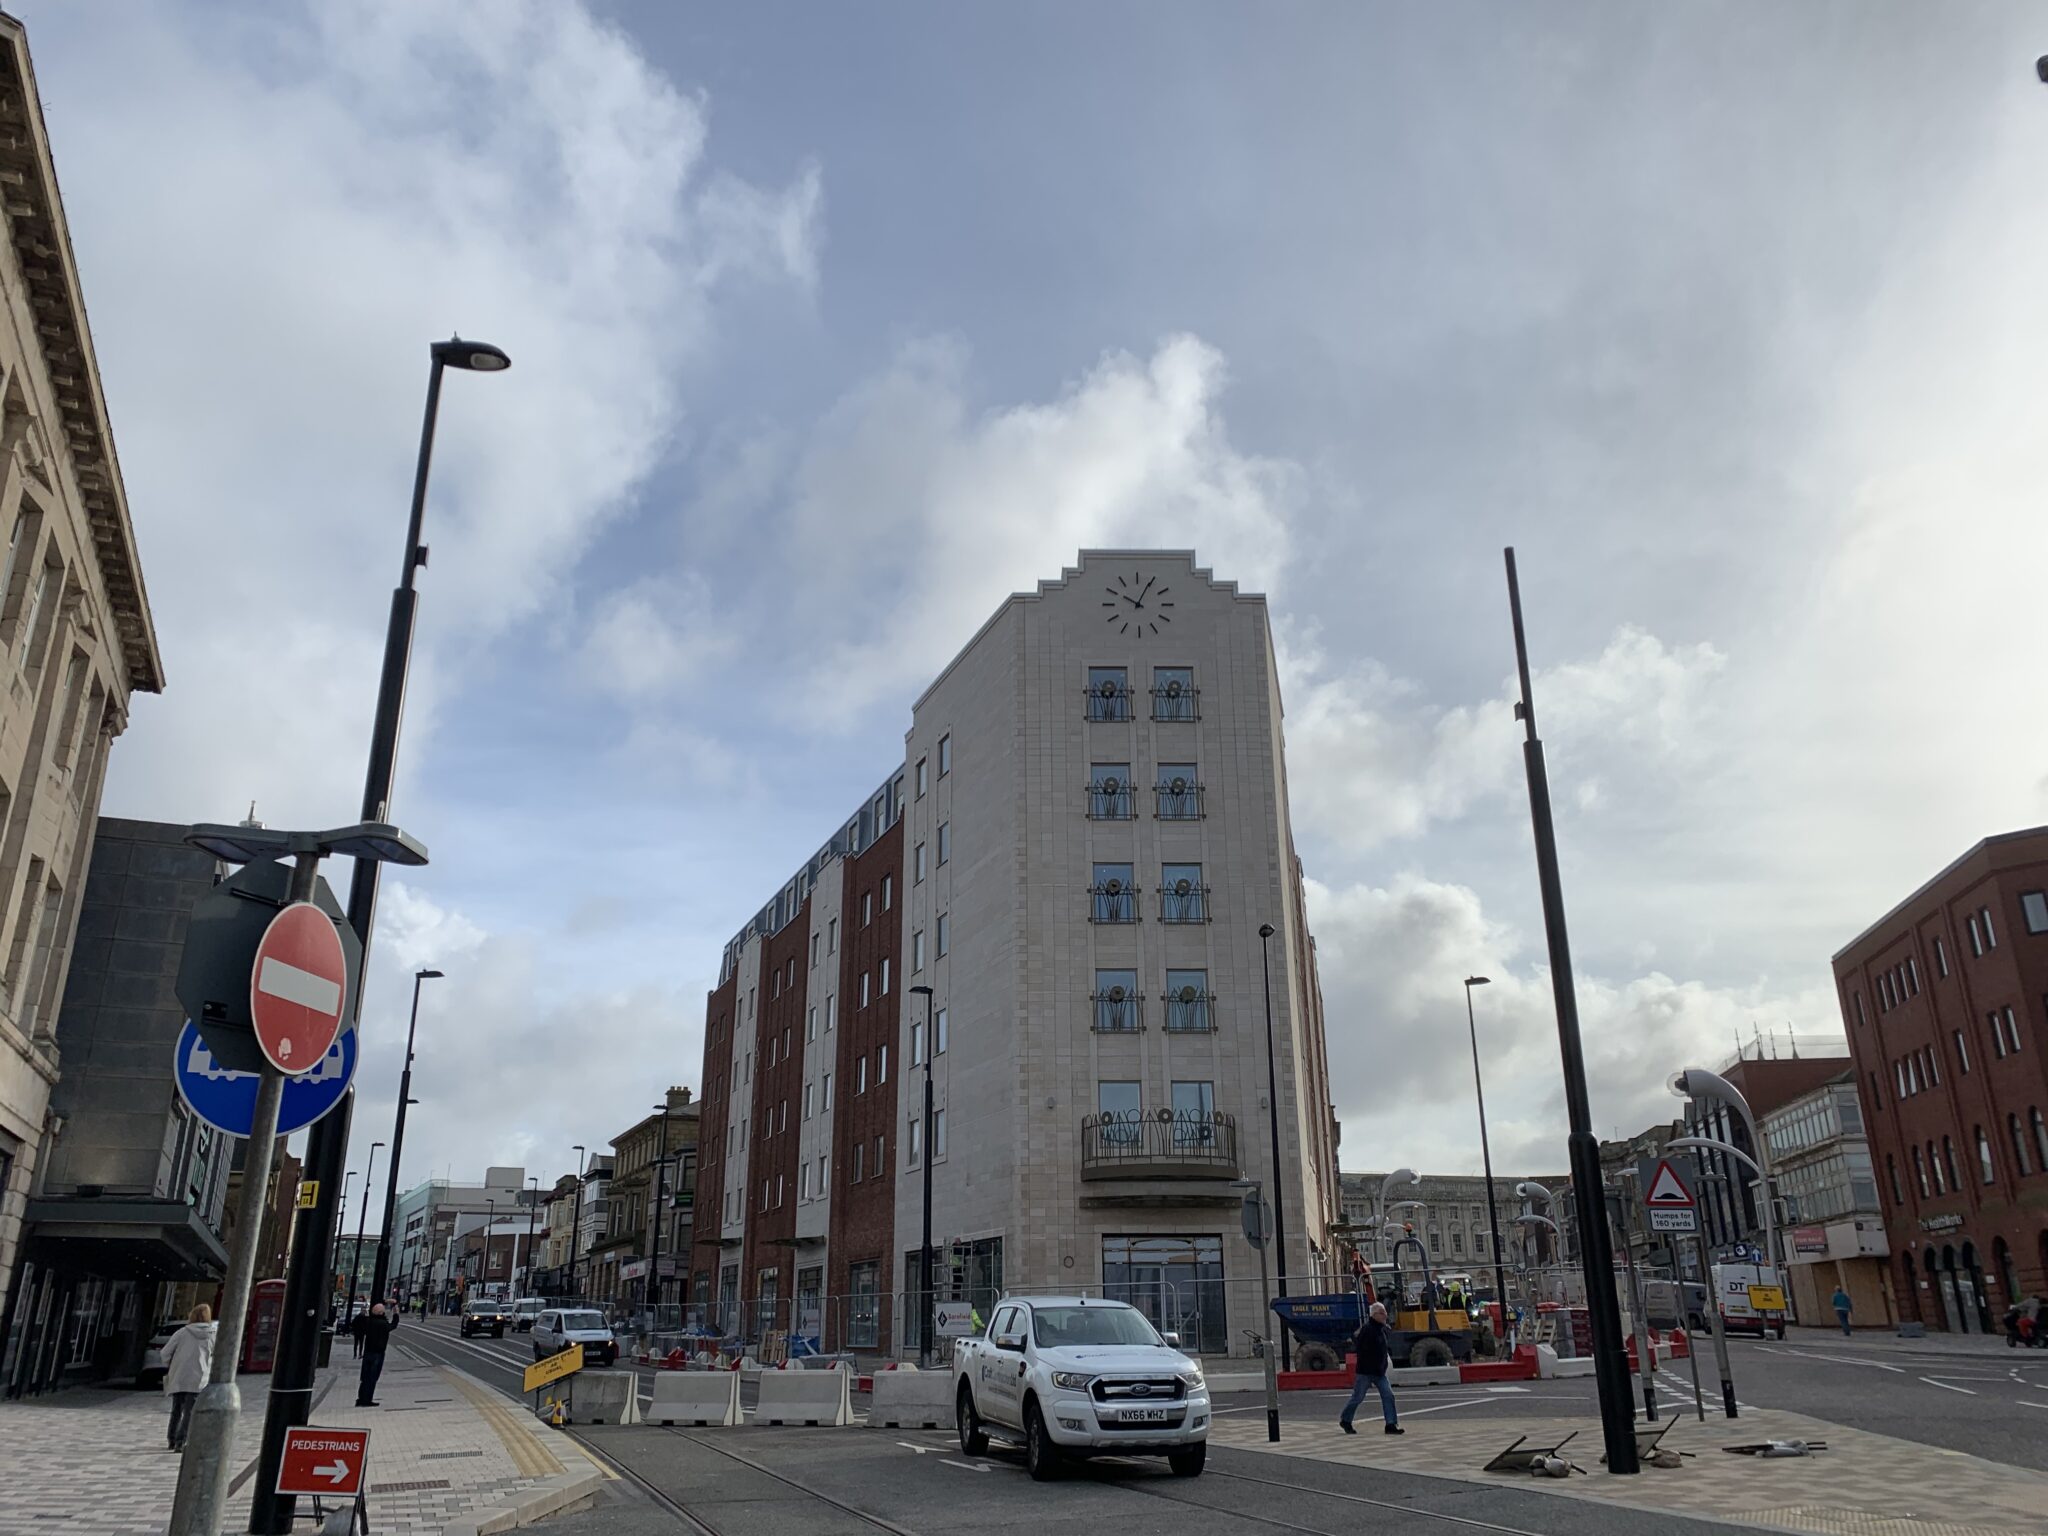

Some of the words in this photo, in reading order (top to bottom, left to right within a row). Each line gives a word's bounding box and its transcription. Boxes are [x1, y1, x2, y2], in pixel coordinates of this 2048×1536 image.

[1671, 1220, 1691, 1228] yards
[1729, 1281, 1745, 1291] DT
[1292, 1304, 1309, 1312] EAGLE
[1311, 1304, 1330, 1312] PLANT
[1121, 1410, 1145, 1420] NX66
[1147, 1410, 1164, 1420] WHZ
[291, 1440, 360, 1452] PEDESTRIANS
